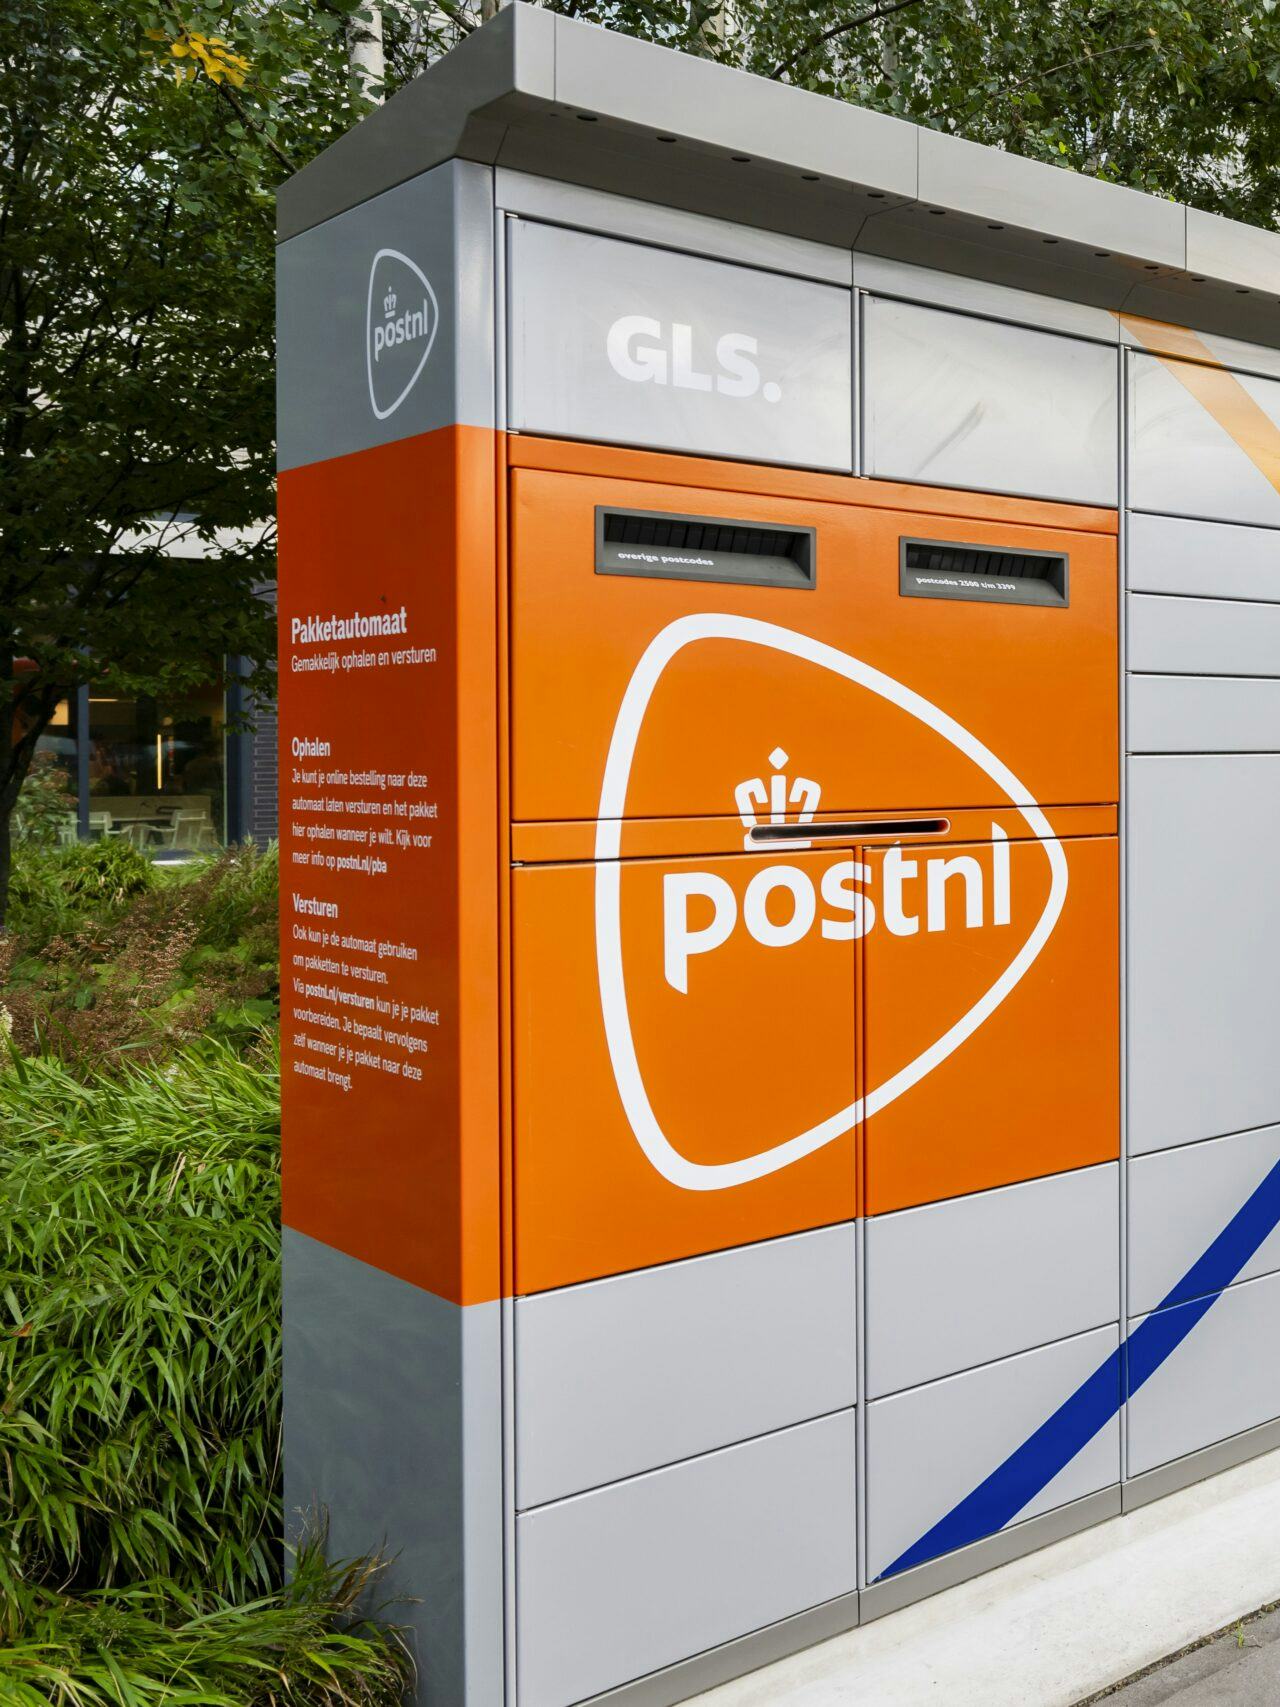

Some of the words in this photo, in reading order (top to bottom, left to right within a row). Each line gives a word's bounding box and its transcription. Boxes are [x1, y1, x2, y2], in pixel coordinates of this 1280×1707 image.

[374, 298, 428, 362] postnl
[618, 551, 659, 562] overige
[661, 556, 714, 566] postcodes
[916, 577, 958, 586] postcodes
[291, 606, 408, 644] Pakketautomaat
[291, 652, 340, 674] Gemakkelijk
[342, 649, 376, 673] ophalen
[378, 651, 389, 665] en
[392, 646, 436, 665] versturen
[292, 736, 330, 762] Ophalen
[292, 768, 300, 783] Je
[301, 769, 317, 784] kunt
[317, 769, 325, 788] je
[326, 770, 348, 785] online
[349, 769, 386, 790] bestelling
[387, 773, 405, 787] naar
[408, 771, 427, 788] deze
[292, 796, 325, 811] automaat
[325, 797, 344, 812] laten
[345, 799, 381, 814] versturen
[383, 803, 392, 815] en
[394, 800, 408, 817] het
[409, 801, 438, 821] pakket
[292, 822, 305, 837] hier
[307, 824, 335, 841] ophalen
[336, 829, 368, 842] wanneer
[368, 828, 376, 847] je
[378, 828, 394, 845] wilt.
[396, 829, 411, 850] Kijk
[413, 834, 432, 848] voor
[292, 851, 309, 864] meer
[311, 850, 324, 866] info
[326, 855, 335, 871] op
[337, 855, 387, 876] postnl.nl/pba
[292, 892, 339, 919] Versturen
[663, 821, 1011, 995] postnl
[292, 924, 307, 940] Ook
[308, 927, 321, 943] kun
[322, 929, 330, 947] je
[330, 930, 340, 946] de
[341, 934, 377, 953] automaat
[377, 940, 418, 961] gebruiken
[292, 954, 304, 966] om
[305, 955, 340, 974] pakketten
[341, 962, 349, 976] te
[350, 965, 389, 984] versturen.
[293, 977, 304, 994] Via
[305, 981, 375, 1009] postnl.nl/versturen
[376, 996, 391, 1015] kun
[391, 1000, 400, 1019] je
[400, 1001, 409, 1021] je
[410, 1005, 440, 1026] pakket
[293, 1007, 341, 1030] voorbereiden.
[342, 1016, 352, 1033] Je
[353, 1019, 383, 1041] bepaalt
[384, 1029, 428, 1053] vervolgens
[293, 1033, 306, 1048] zelf
[306, 1037, 337, 1056] wanneer
[338, 1043, 345, 1062] je
[346, 1045, 354, 1064] je
[355, 1050, 381, 1069] pakket
[383, 1058, 400, 1075] naar
[402, 1061, 423, 1081] deze
[293, 1061, 326, 1081] automaat
[327, 1067, 353, 1091] brengt.
